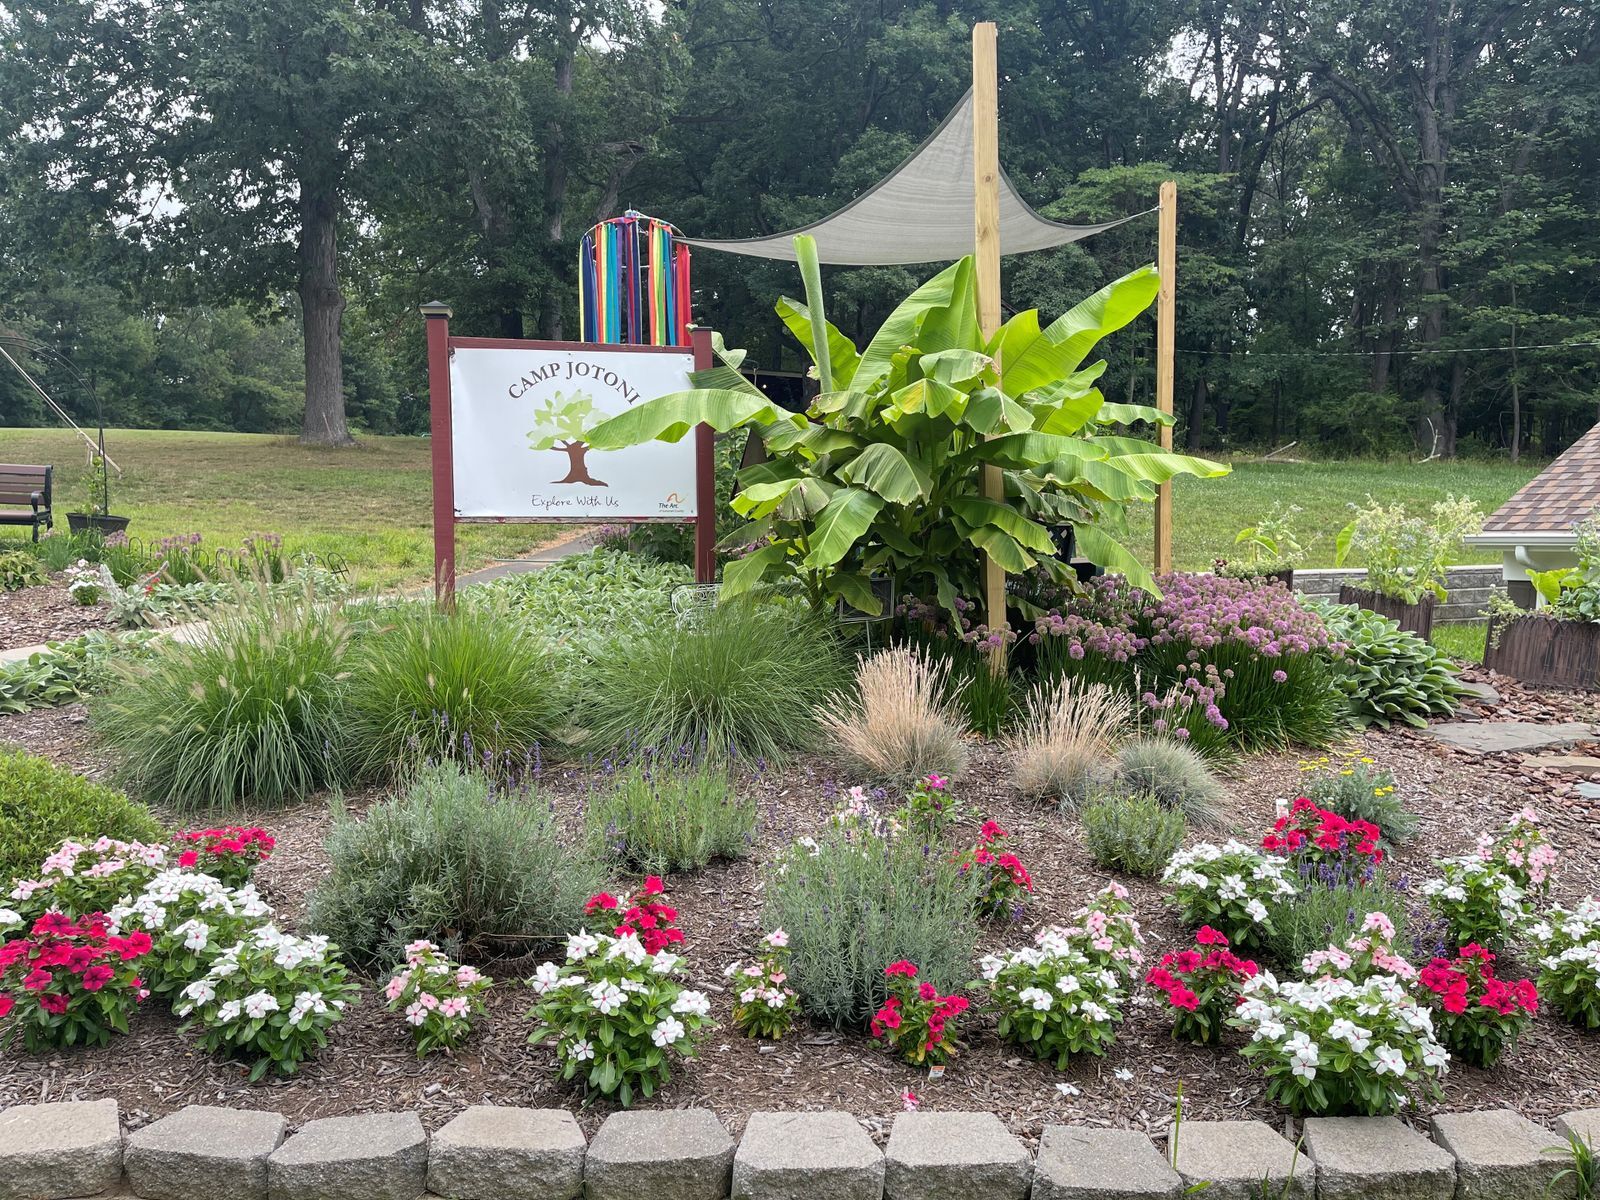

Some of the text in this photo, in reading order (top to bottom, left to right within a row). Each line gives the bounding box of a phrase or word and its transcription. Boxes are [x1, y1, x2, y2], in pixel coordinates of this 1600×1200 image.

[508, 361, 641, 405] CAMP JOTONI
[531, 494, 619, 511] Explore With Us
